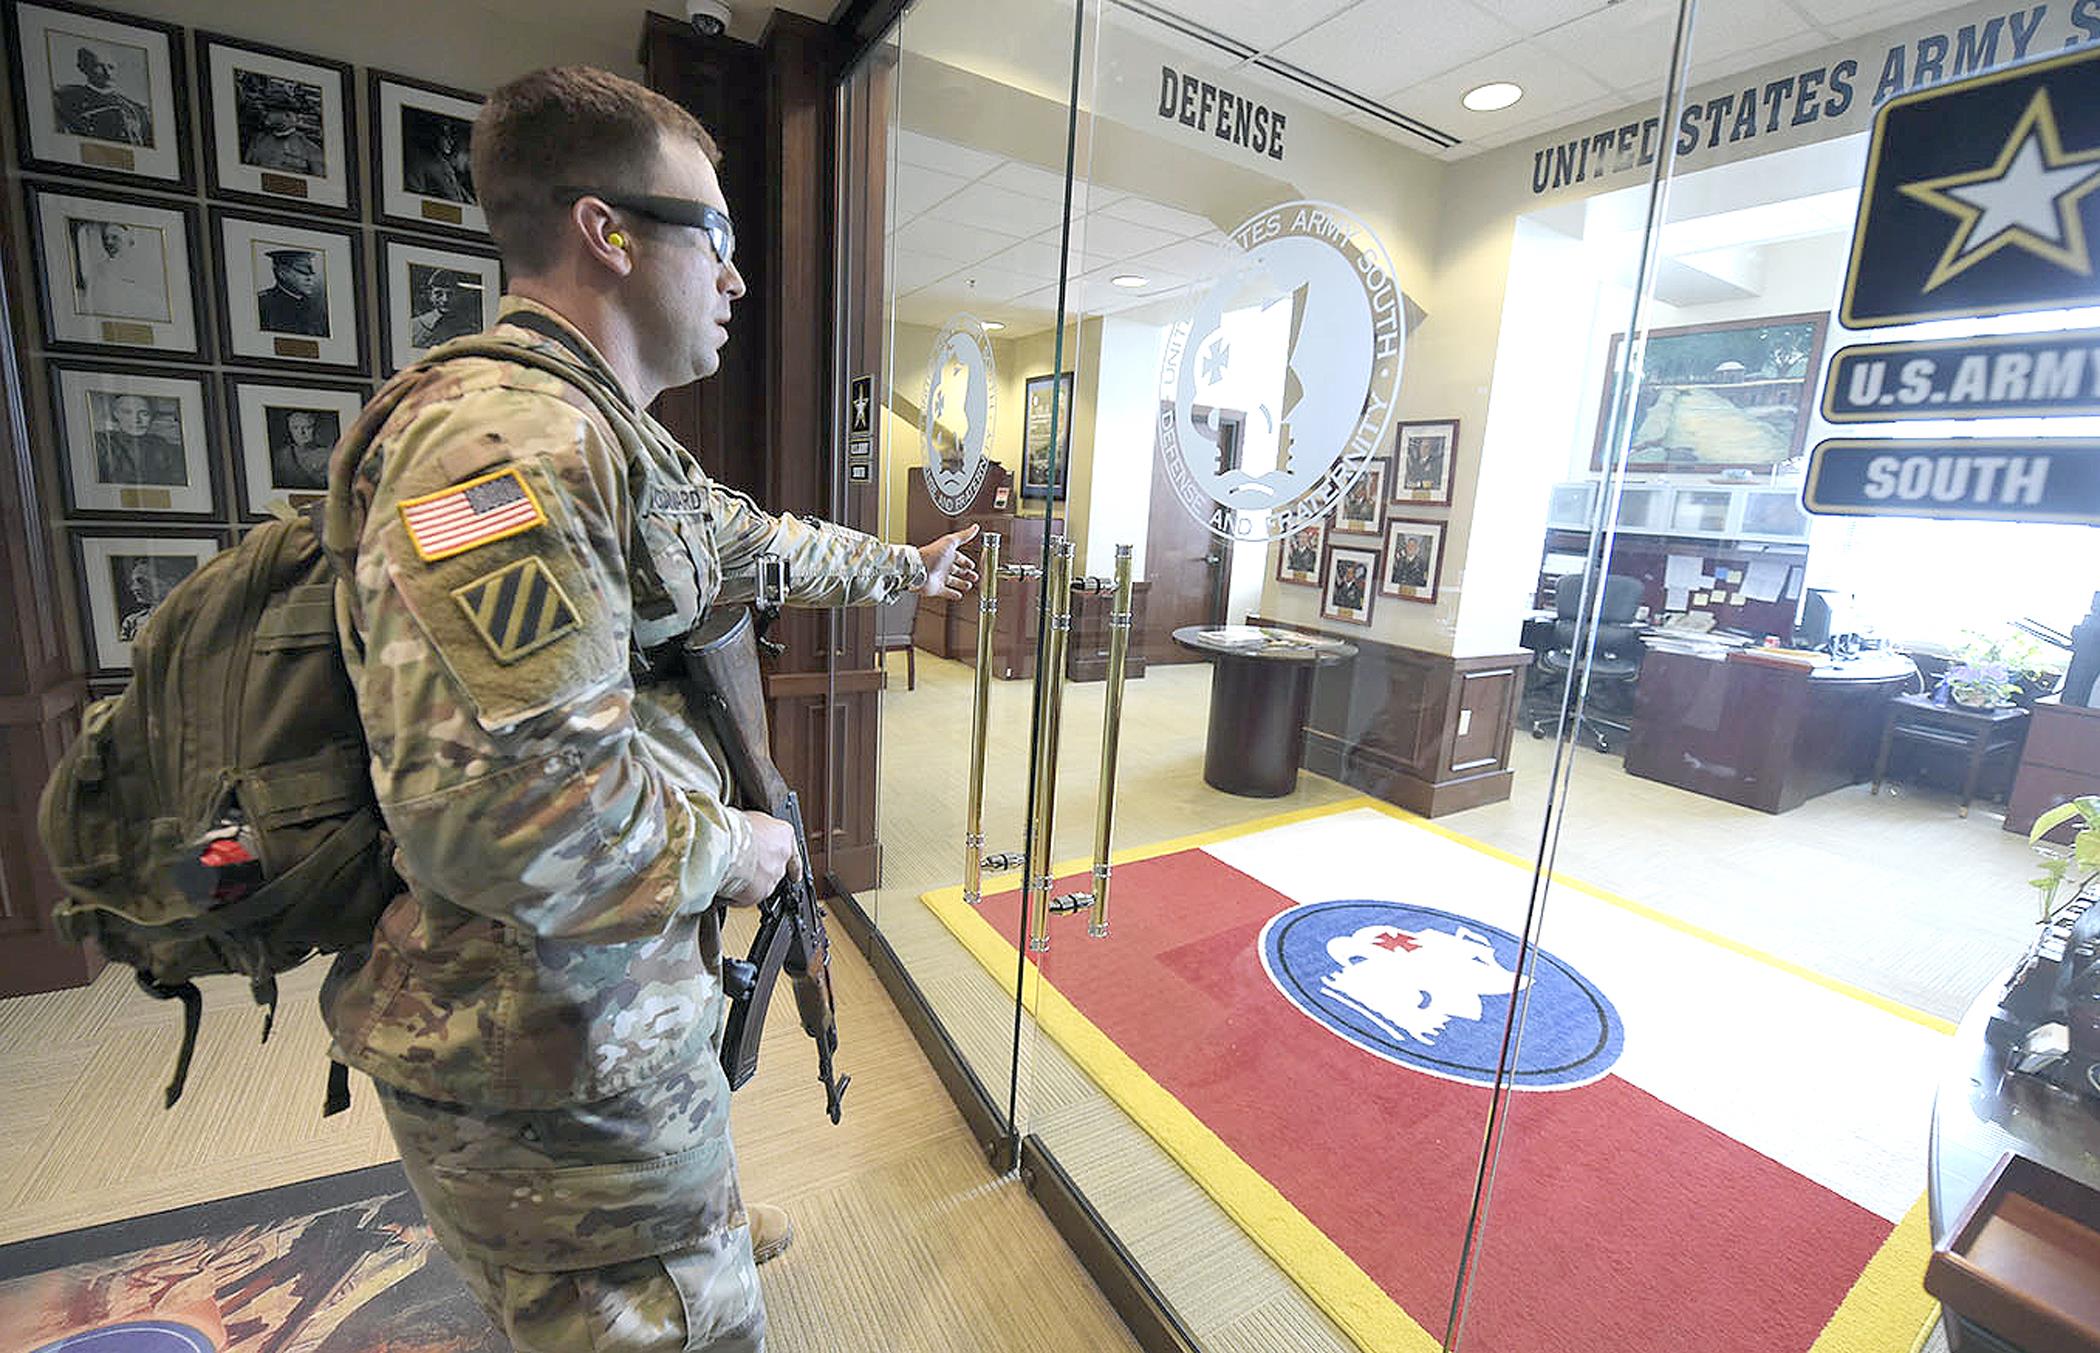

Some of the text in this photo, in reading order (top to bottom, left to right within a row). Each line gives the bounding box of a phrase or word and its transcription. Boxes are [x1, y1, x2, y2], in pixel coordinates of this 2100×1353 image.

[1158, 66, 1287, 161] DEFENSE
[1532, 117, 1660, 194] UNITED
[1676, 59, 1858, 156] STATES
[1872, 5, 2047, 106] ARMY
[1291, 208, 1359, 249] ARMY
[1357, 248, 1399, 359] SOUTH
[1848, 349, 2100, 407] U.S.ARM
[1161, 391, 1389, 536] DEFENSE AND FRATERNITY
[1863, 455, 2051, 505] SOUTH
